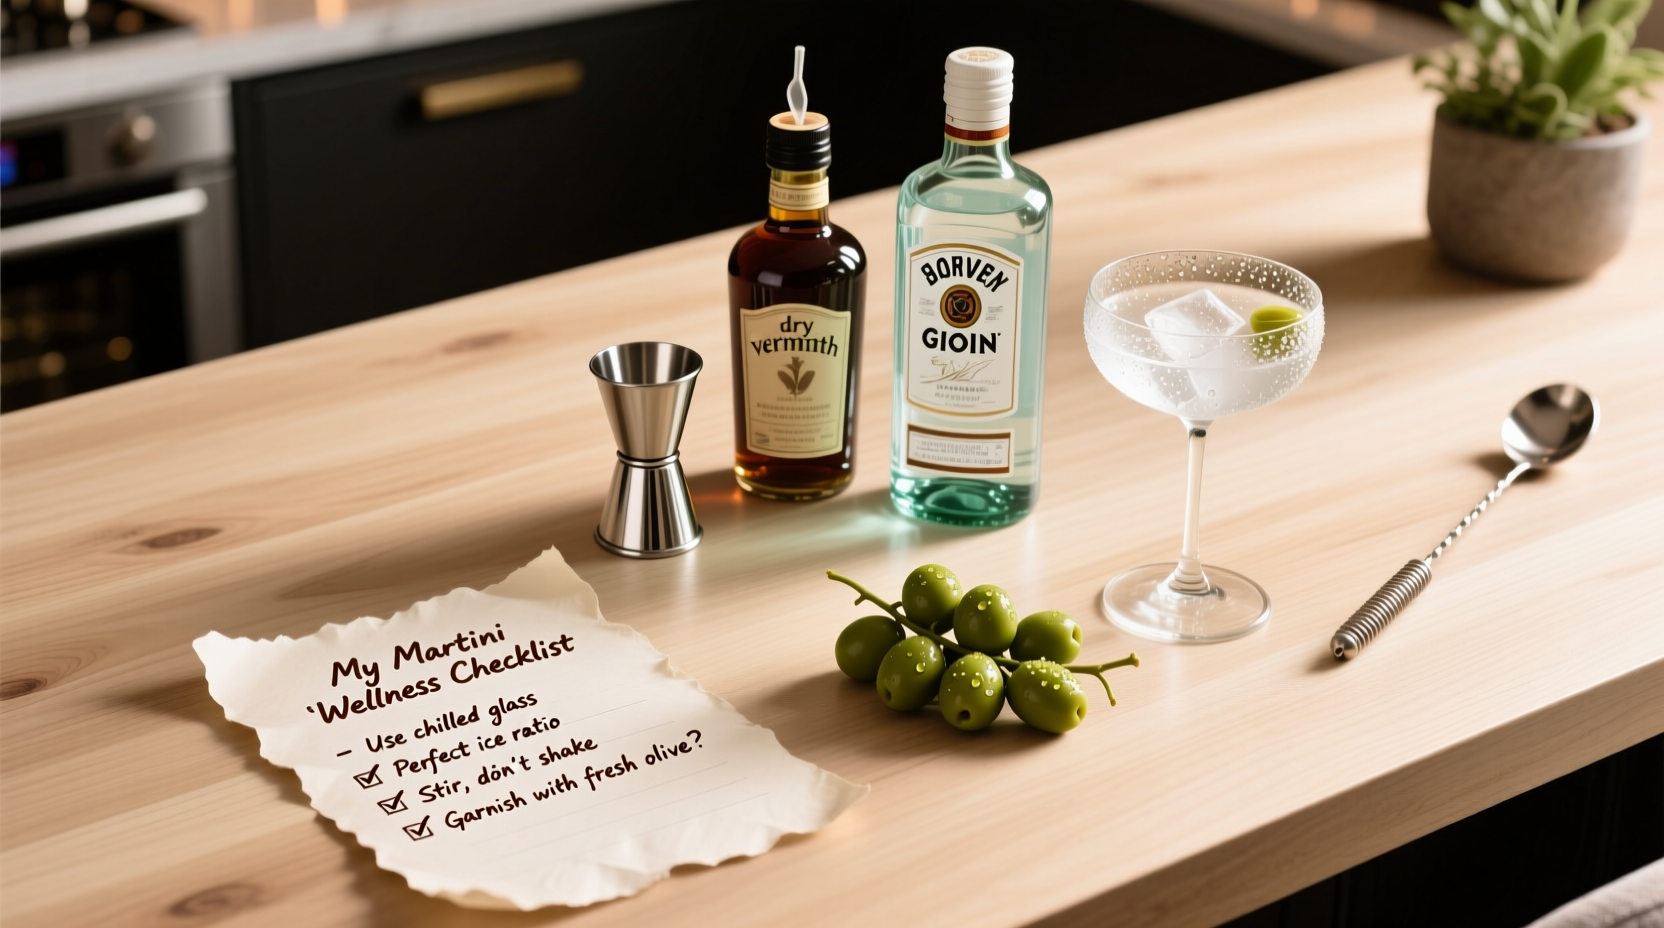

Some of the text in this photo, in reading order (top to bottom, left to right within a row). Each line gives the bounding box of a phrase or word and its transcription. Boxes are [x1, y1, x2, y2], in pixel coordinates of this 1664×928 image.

[920, 255, 1010, 293] BORVEN
[780, 315, 814, 338] dry
[331, 623, 506, 688] My Martini
[450, 634, 575, 684] Checklist
[365, 733, 408, 753] Use
[413, 704, 481, 739] chilled
[488, 693, 538, 727] glass
[392, 716, 561, 778] Perfect ice ratio
[418, 779, 471, 804] Stir,
[538, 738, 599, 767] shake
[444, 729, 703, 832] Garnish with fresh olive?
